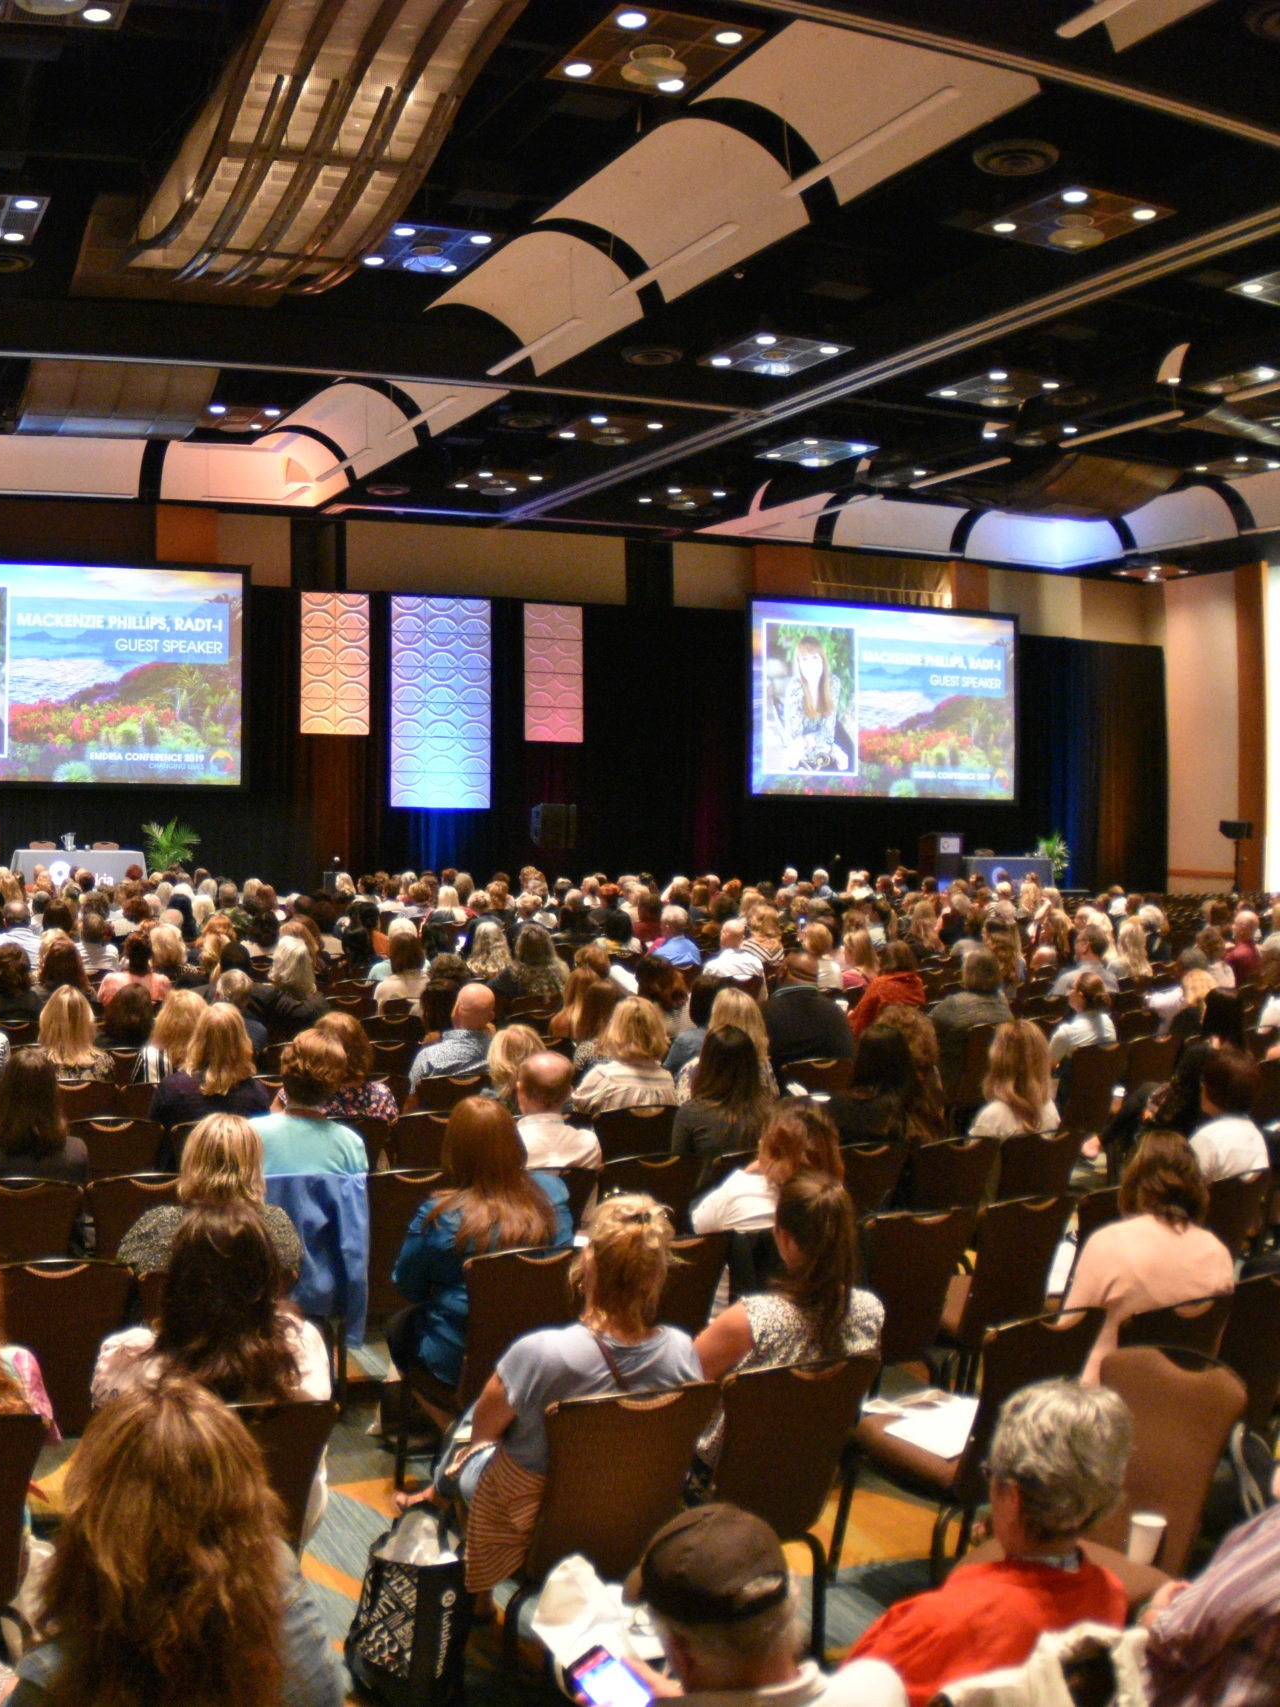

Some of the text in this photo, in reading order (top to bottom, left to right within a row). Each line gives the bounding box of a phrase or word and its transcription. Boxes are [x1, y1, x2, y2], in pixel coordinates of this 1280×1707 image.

[17, 613, 223, 632] MACKENZIE PHILLIPS, RADT-I
[115, 638, 223, 655] GUEST SPEAKER
[929, 674, 1002, 689] GUEST SPEAKER
[90, 752, 205, 763] EMDRIA CONFERENCE 2019
